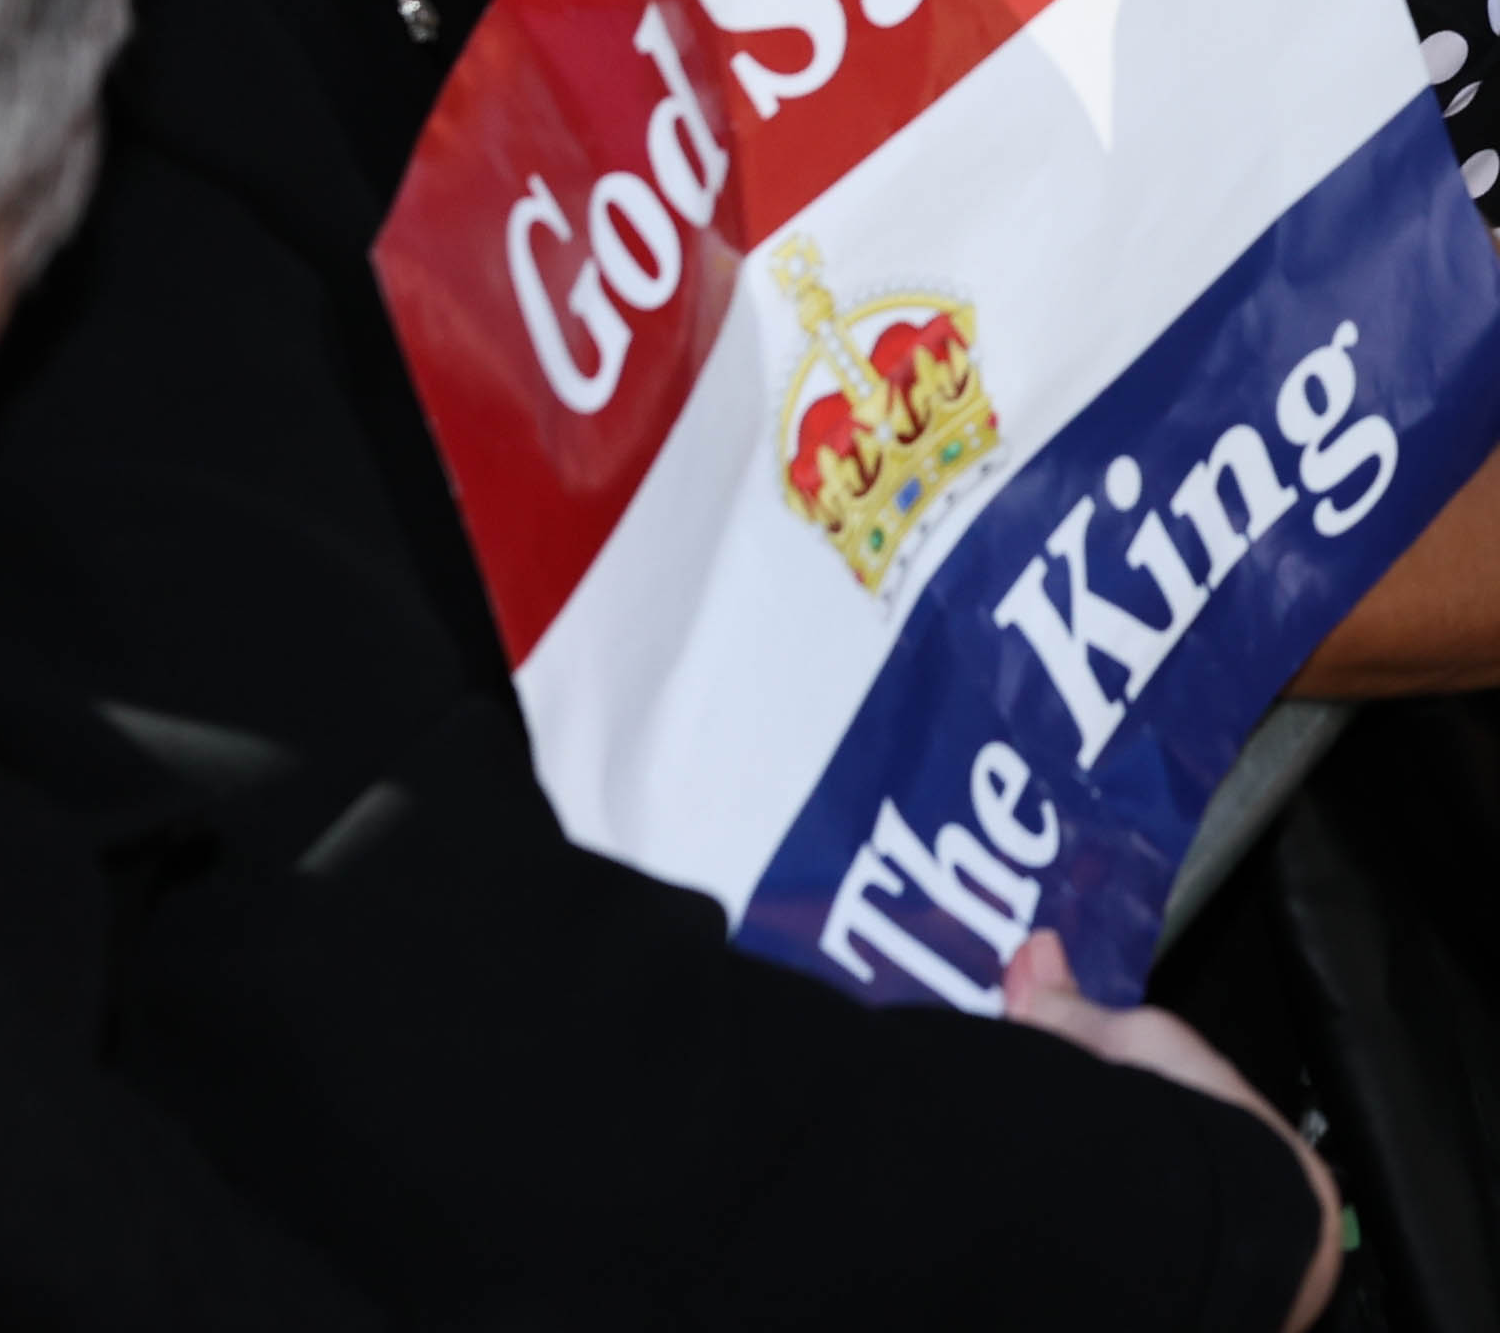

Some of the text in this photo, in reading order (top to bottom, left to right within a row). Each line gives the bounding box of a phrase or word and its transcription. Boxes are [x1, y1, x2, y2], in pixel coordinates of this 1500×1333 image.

[506, 0, 730, 413] God
[818, 319, 1399, 1018] The King
